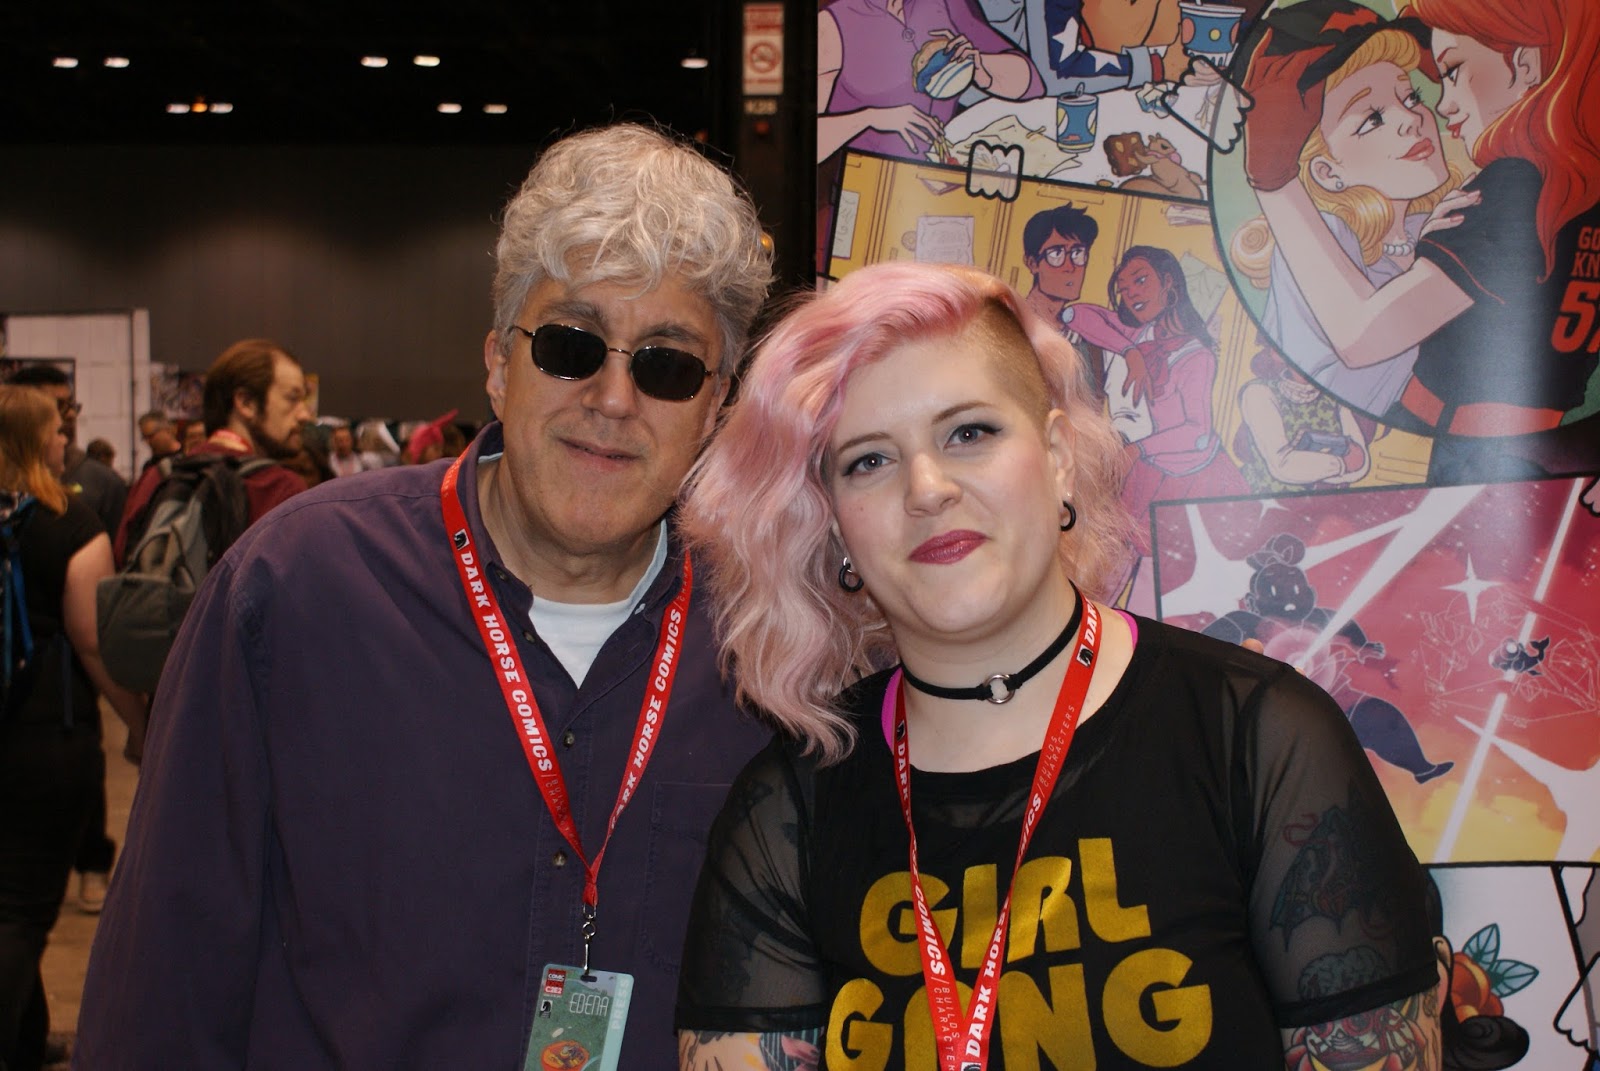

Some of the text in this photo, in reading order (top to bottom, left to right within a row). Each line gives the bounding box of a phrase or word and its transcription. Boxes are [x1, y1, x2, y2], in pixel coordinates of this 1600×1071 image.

[1551, 280, 1600, 354] 5
[460, 551, 553, 772] DARK HORSE COMICS
[633, 695, 662, 768] HORSE
[654, 608, 682, 692] COMICS
[898, 744, 910, 801] DARK
[1039, 735, 1058, 785] BUILDS
[1043, 704, 1075, 788] CHARACTERS
[859, 837, 1152, 977] GIRL
[915, 884, 946, 976] COMICS
[569, 992, 610, 1017] EDENA
[942, 987, 960, 1039] BUILDS
[965, 985, 992, 1058] DARK
